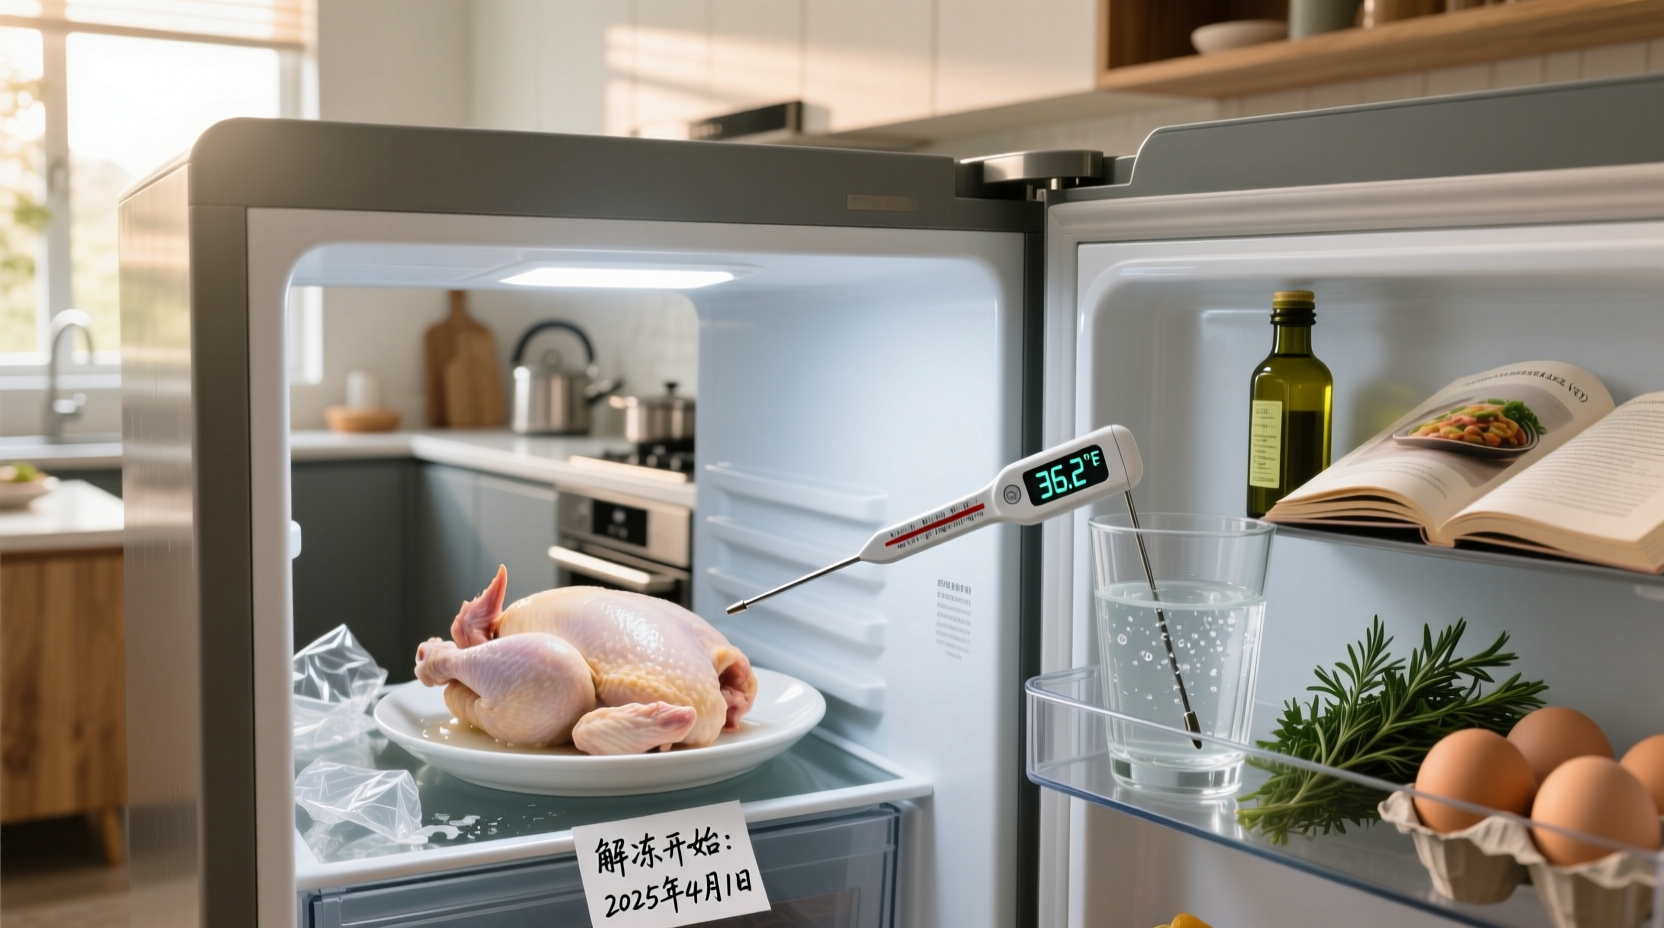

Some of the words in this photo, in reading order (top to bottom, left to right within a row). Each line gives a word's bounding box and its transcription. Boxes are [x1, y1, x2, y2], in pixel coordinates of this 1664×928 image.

[595, 826, 732, 877] 解冻开始：
[605, 869, 752, 918] 2025年4月1日
